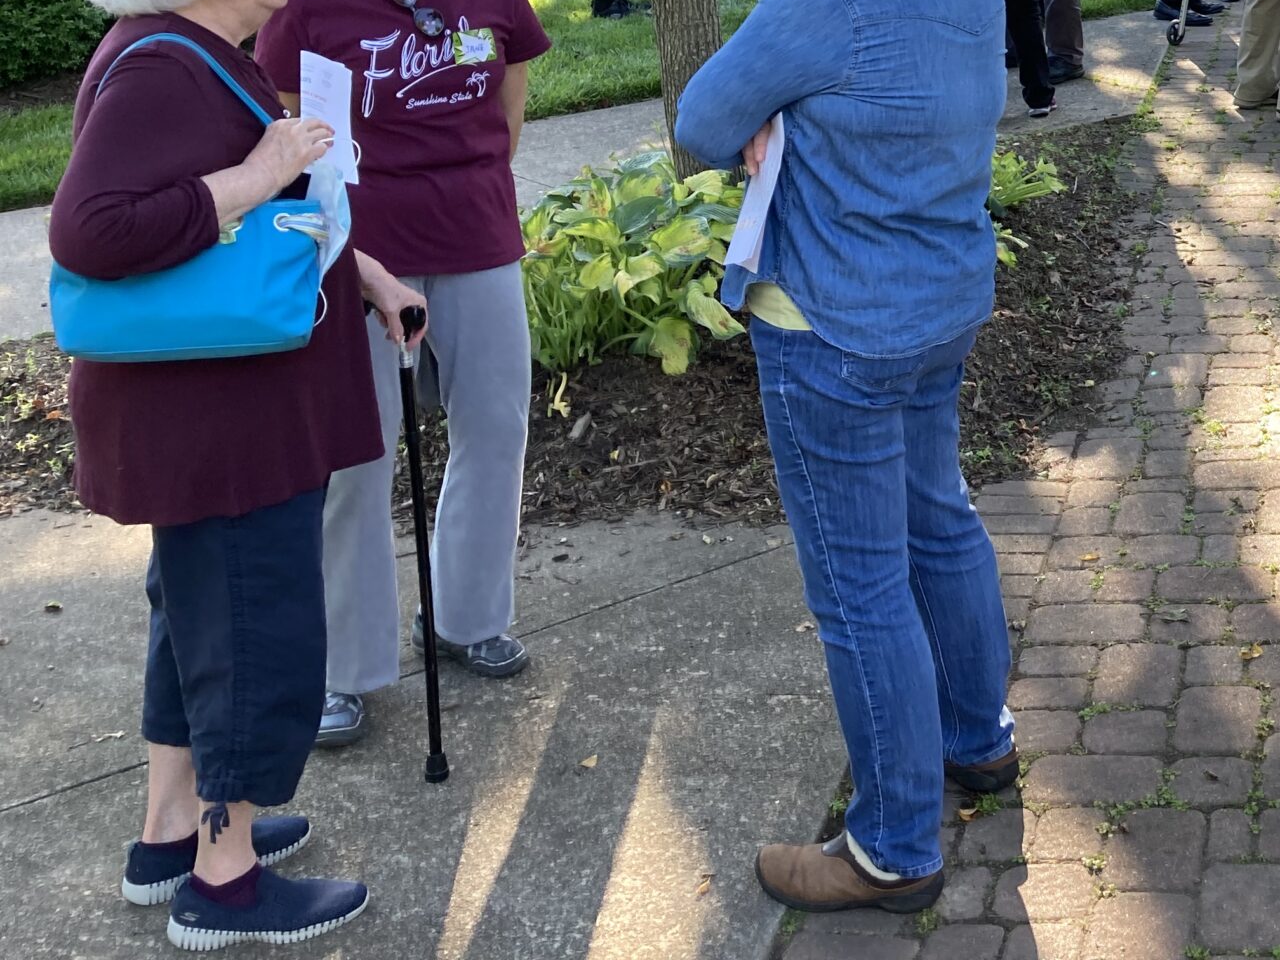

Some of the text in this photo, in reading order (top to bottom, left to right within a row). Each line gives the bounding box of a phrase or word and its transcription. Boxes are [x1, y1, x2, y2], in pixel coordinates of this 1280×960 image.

[360, 16, 470, 117] Flori
[406, 92, 472, 109] Sunshine State
